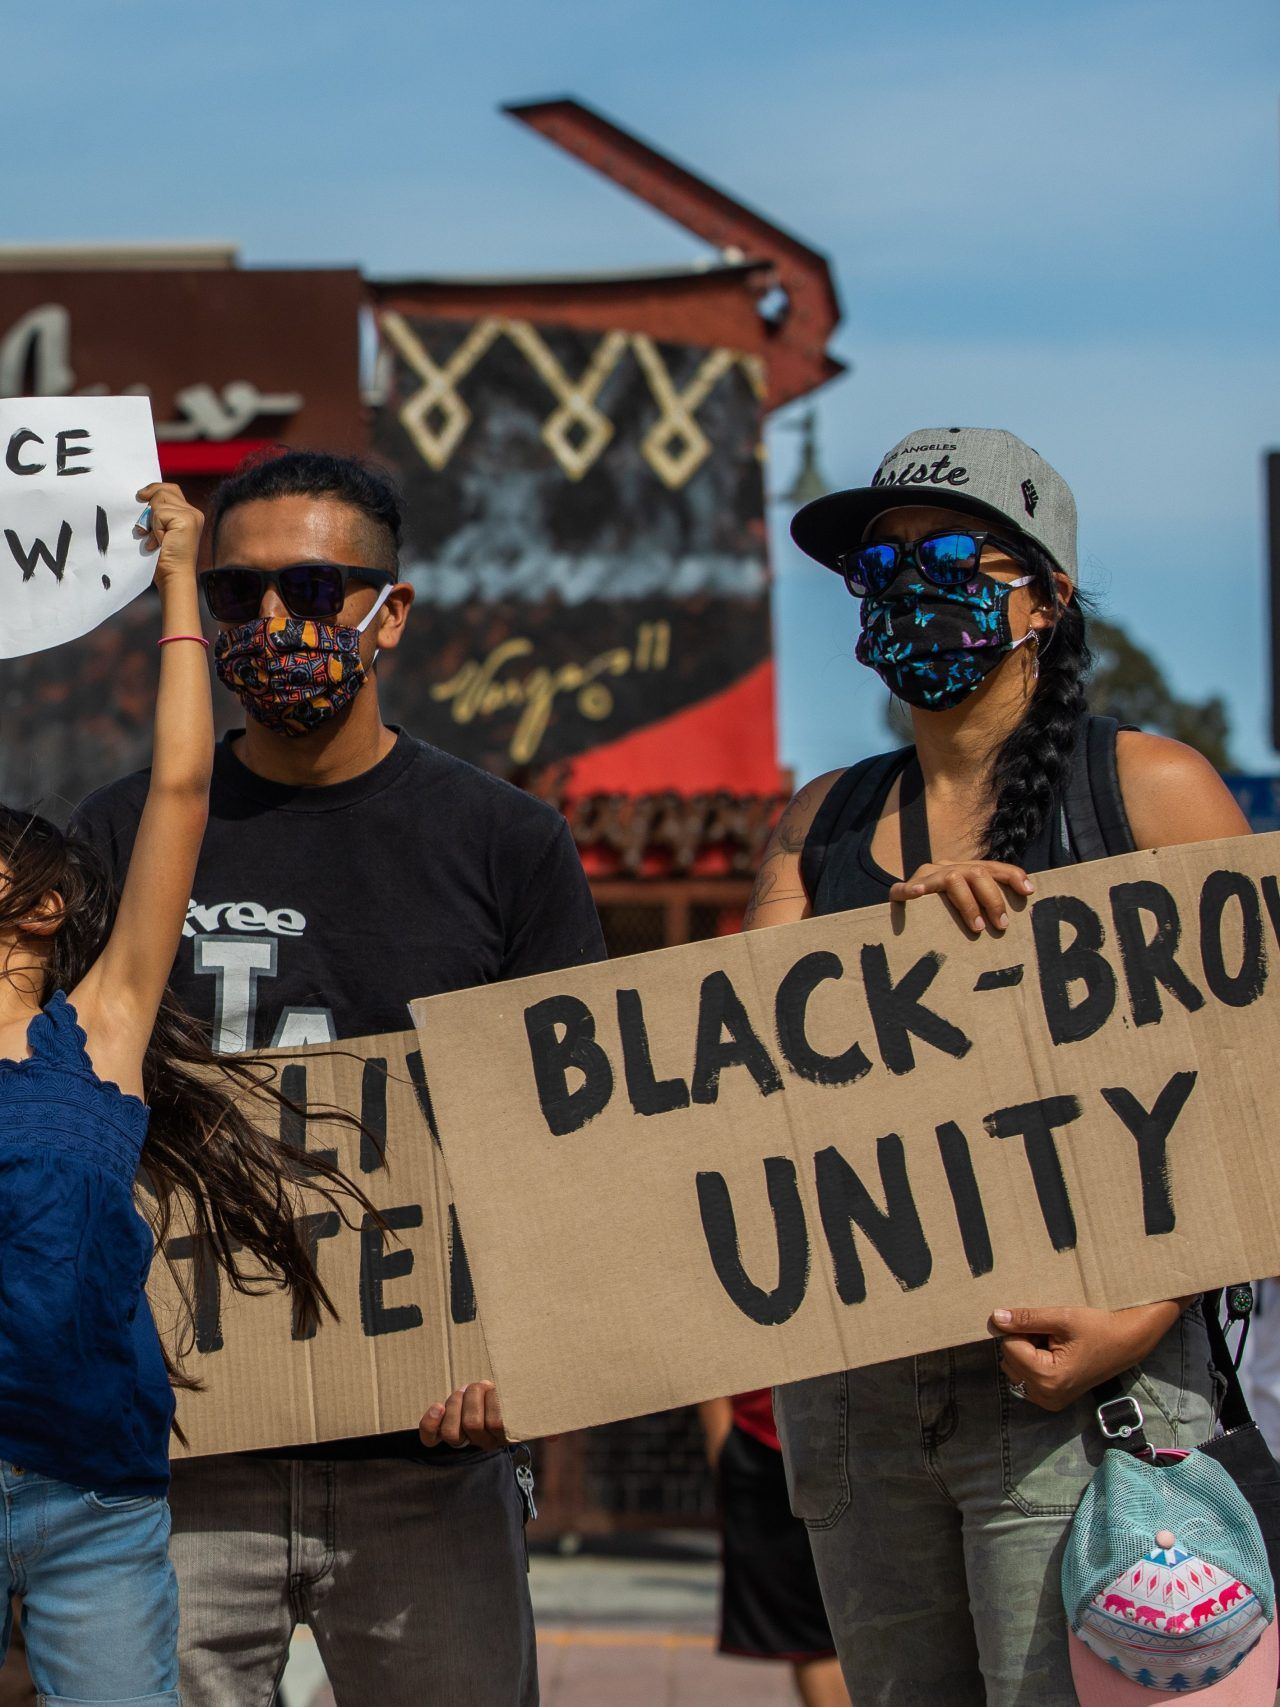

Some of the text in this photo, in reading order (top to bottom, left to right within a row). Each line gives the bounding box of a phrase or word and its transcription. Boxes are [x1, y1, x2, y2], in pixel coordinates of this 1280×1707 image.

[900, 443, 957, 456] ANGELES
[523, 868, 1280, 1137] BLACK-BRO
[695, 1070, 1199, 1327] UNITY
